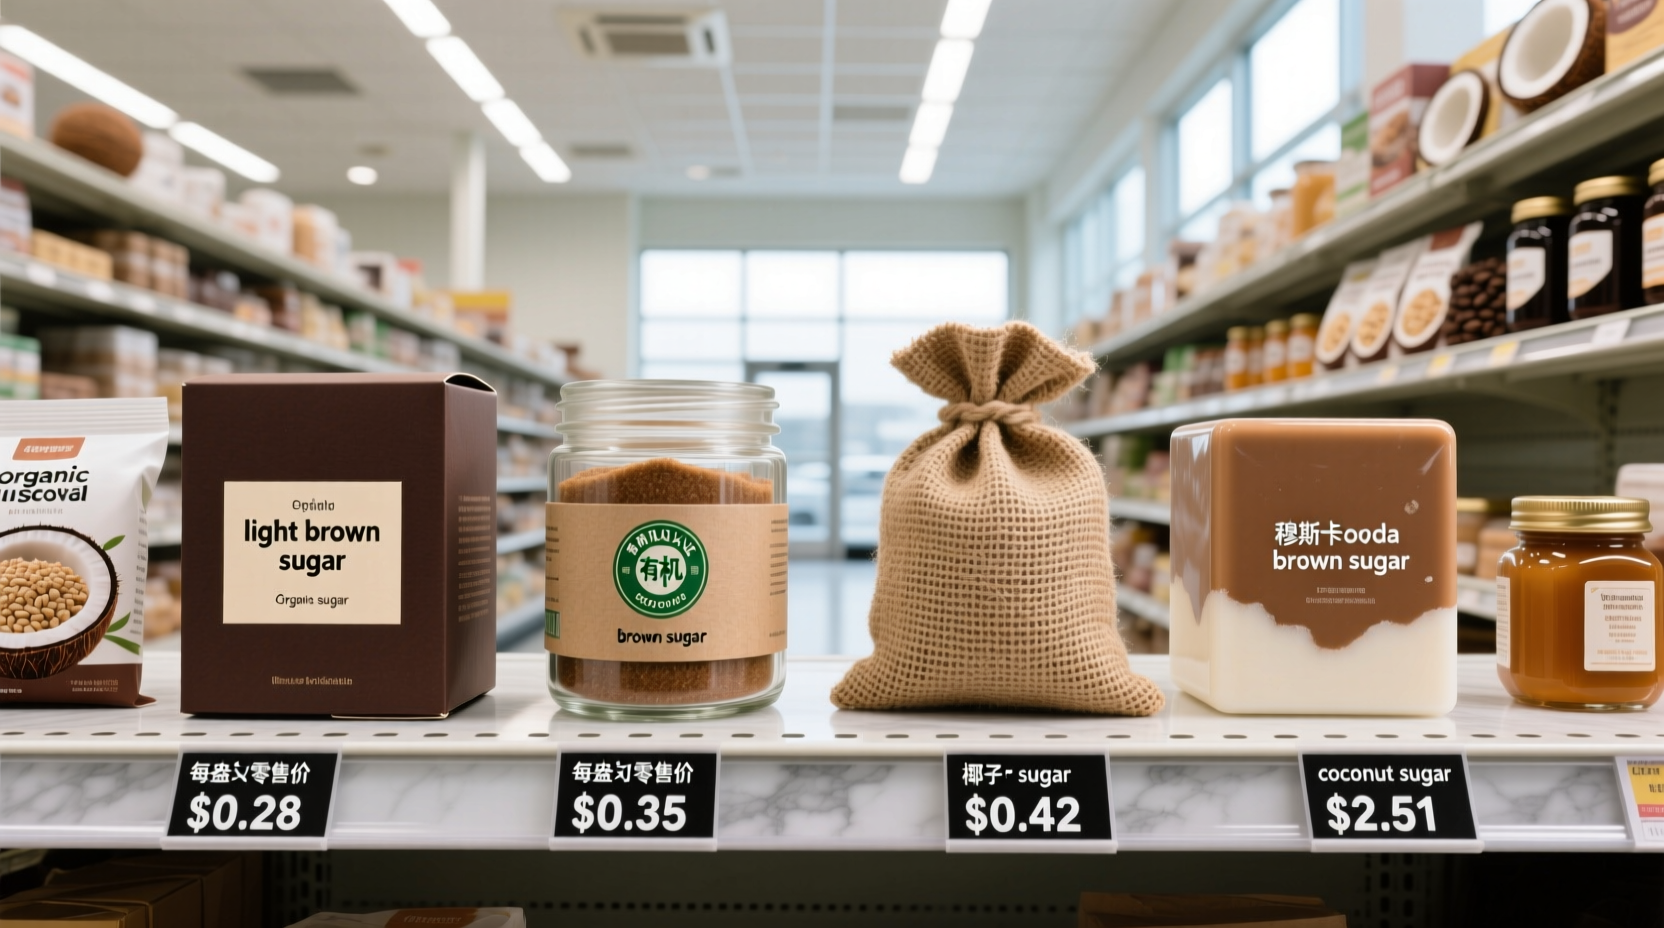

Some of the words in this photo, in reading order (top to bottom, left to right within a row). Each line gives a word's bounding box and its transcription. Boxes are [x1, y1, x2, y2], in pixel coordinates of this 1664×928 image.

[0, 466, 90, 488] organic
[244, 518, 298, 549] light
[305, 518, 380, 542] brown
[278, 553, 347, 578] sugar
[640, 555, 683, 588] 有机
[1272, 548, 1343, 571] brown
[1348, 554, 1410, 577] sugar
[317, 596, 350, 609] sugar
[617, 628, 663, 644] brown
[665, 632, 708, 648] sugar
[1017, 768, 1072, 788] sugar
[1317, 765, 1395, 783] coconut
[1399, 767, 1452, 788] sugar
[186, 791, 302, 834] $0.28
[571, 791, 687, 834] $0.35
[965, 793, 1082, 836] $0.42
[1326, 792, 1437, 836] $2.51
